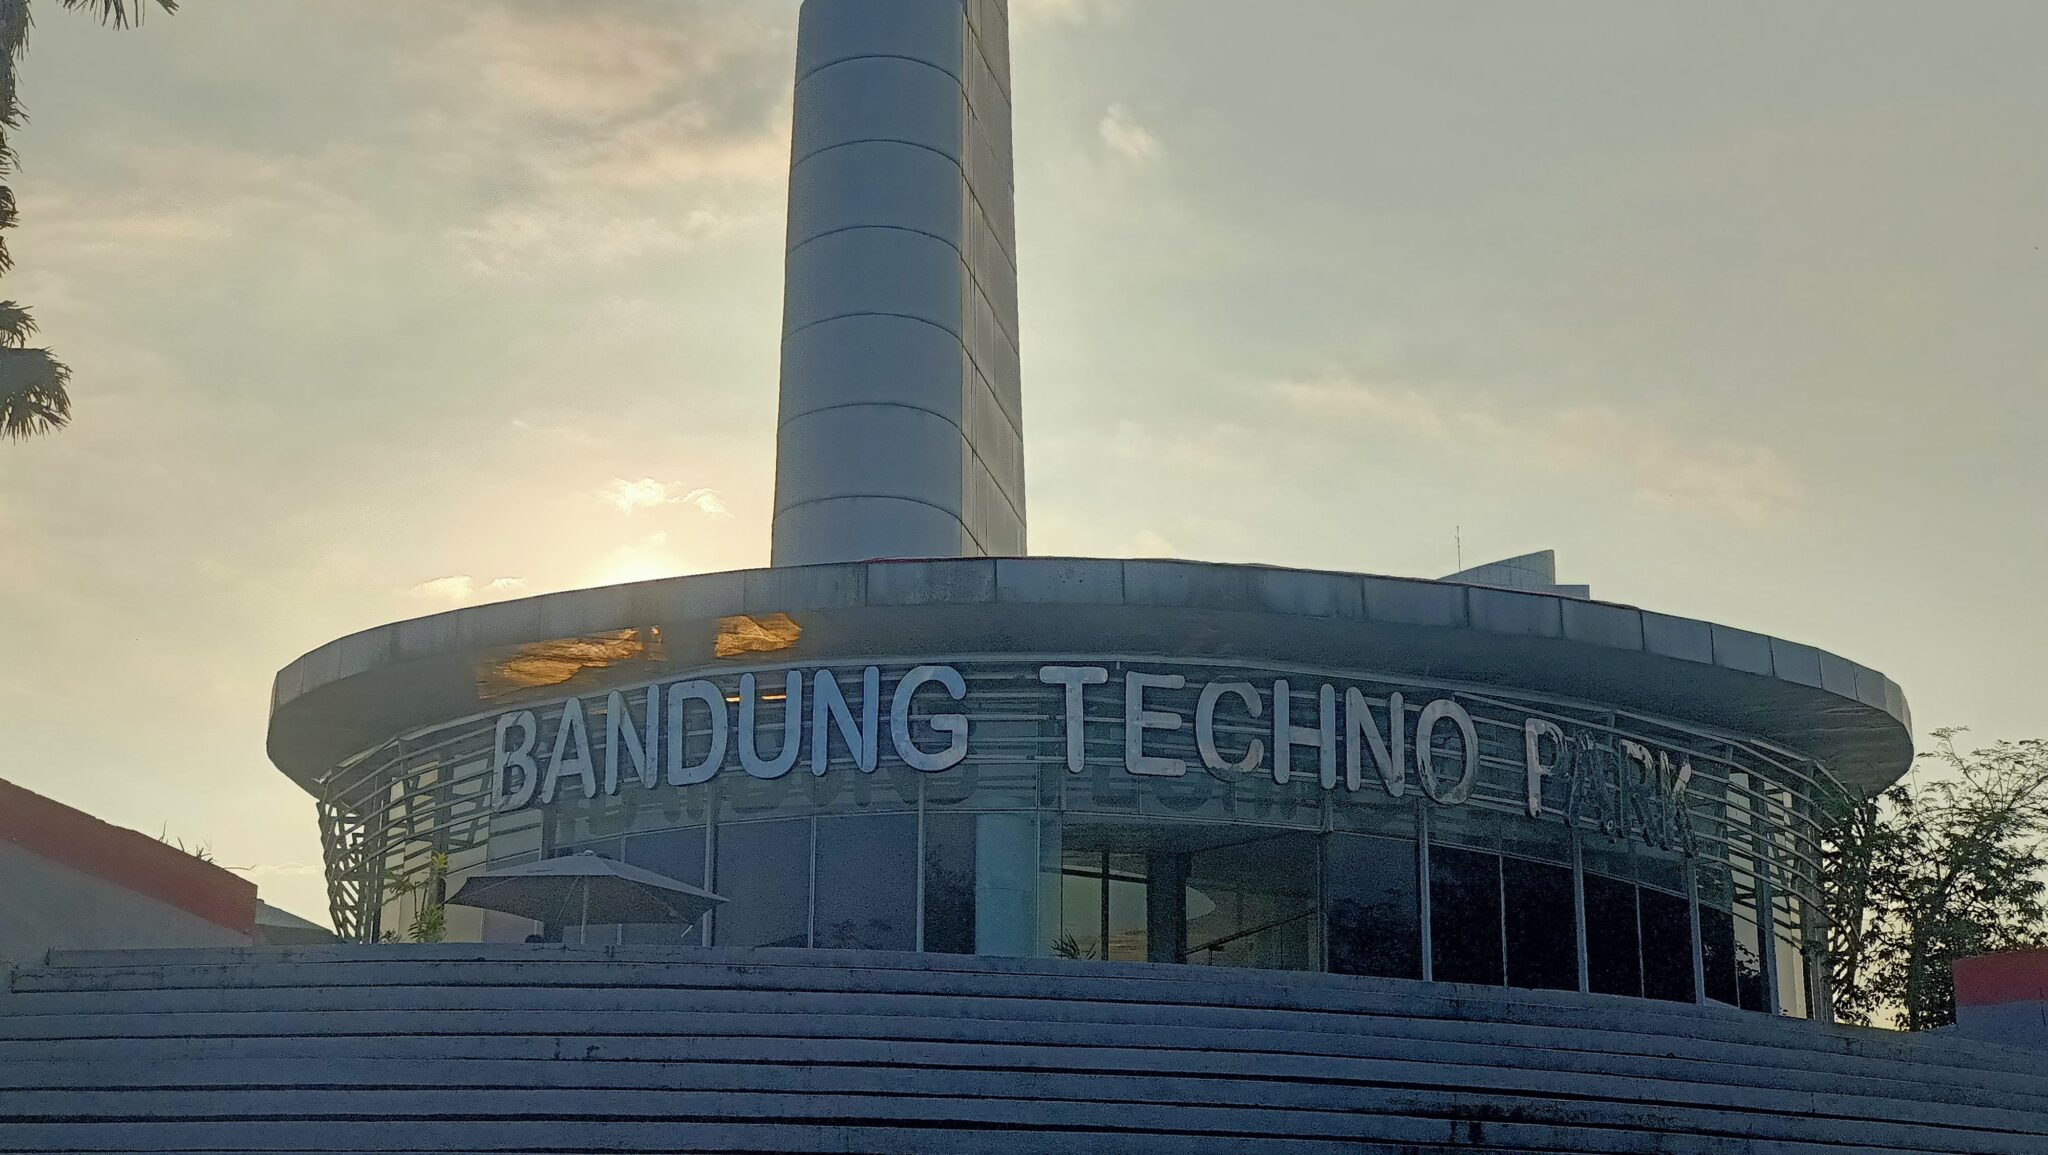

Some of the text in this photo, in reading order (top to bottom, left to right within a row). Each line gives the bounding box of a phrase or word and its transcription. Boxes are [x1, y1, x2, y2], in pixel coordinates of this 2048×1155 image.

[492, 665, 1700, 858] BANDUNG TECHNO PARK
